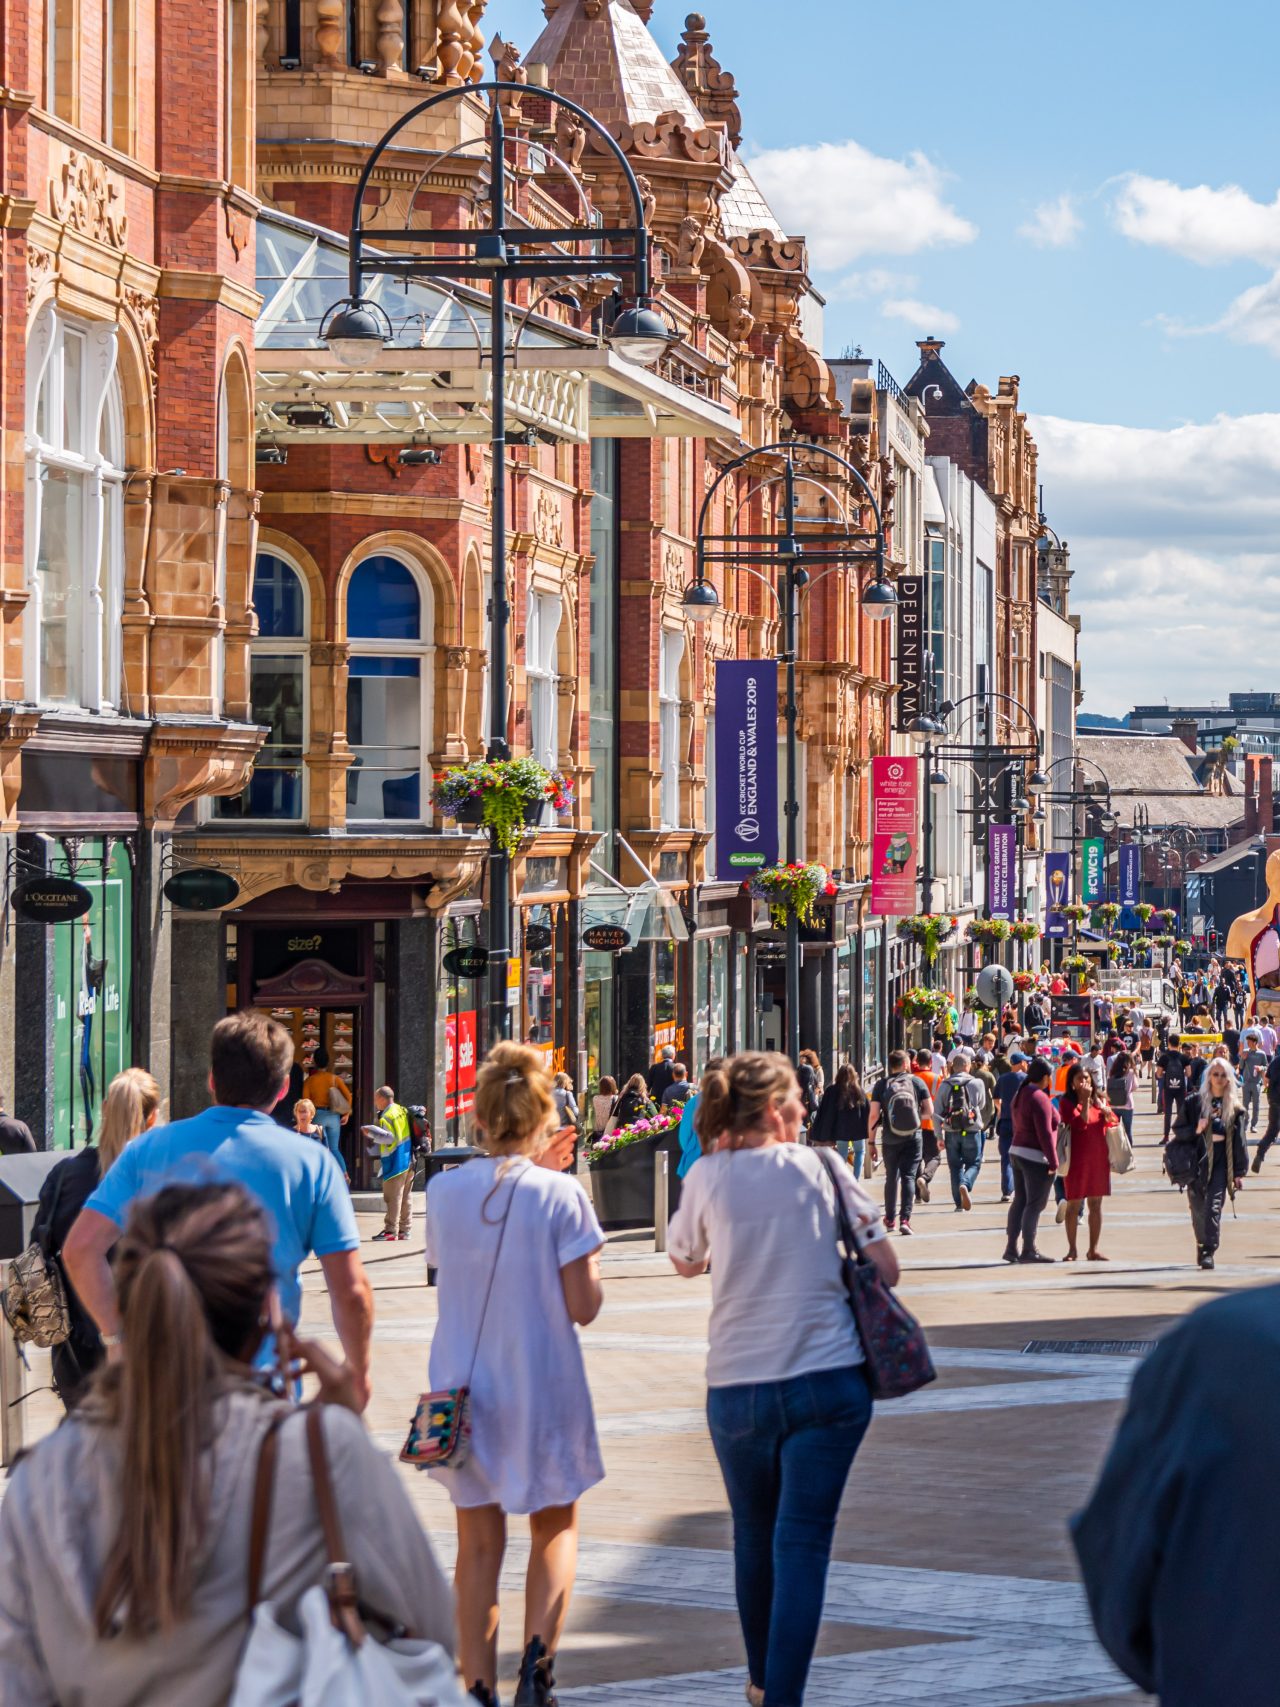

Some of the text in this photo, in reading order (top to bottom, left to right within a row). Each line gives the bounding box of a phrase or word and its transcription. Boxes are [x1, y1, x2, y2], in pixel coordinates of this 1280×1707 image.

[903, 583, 917, 730] DEBENHAMS
[747, 678, 757, 815] ENGLAND & WALES 2019
[730, 855, 765, 866] GoDaddy
[1088, 846, 1098, 895] #CWC19
[25, 892, 80, 902] L'OCCITANE
[288, 934, 322, 950] size?
[57, 984, 120, 1019] In Real Life
[459, 1032, 474, 1068] sale
